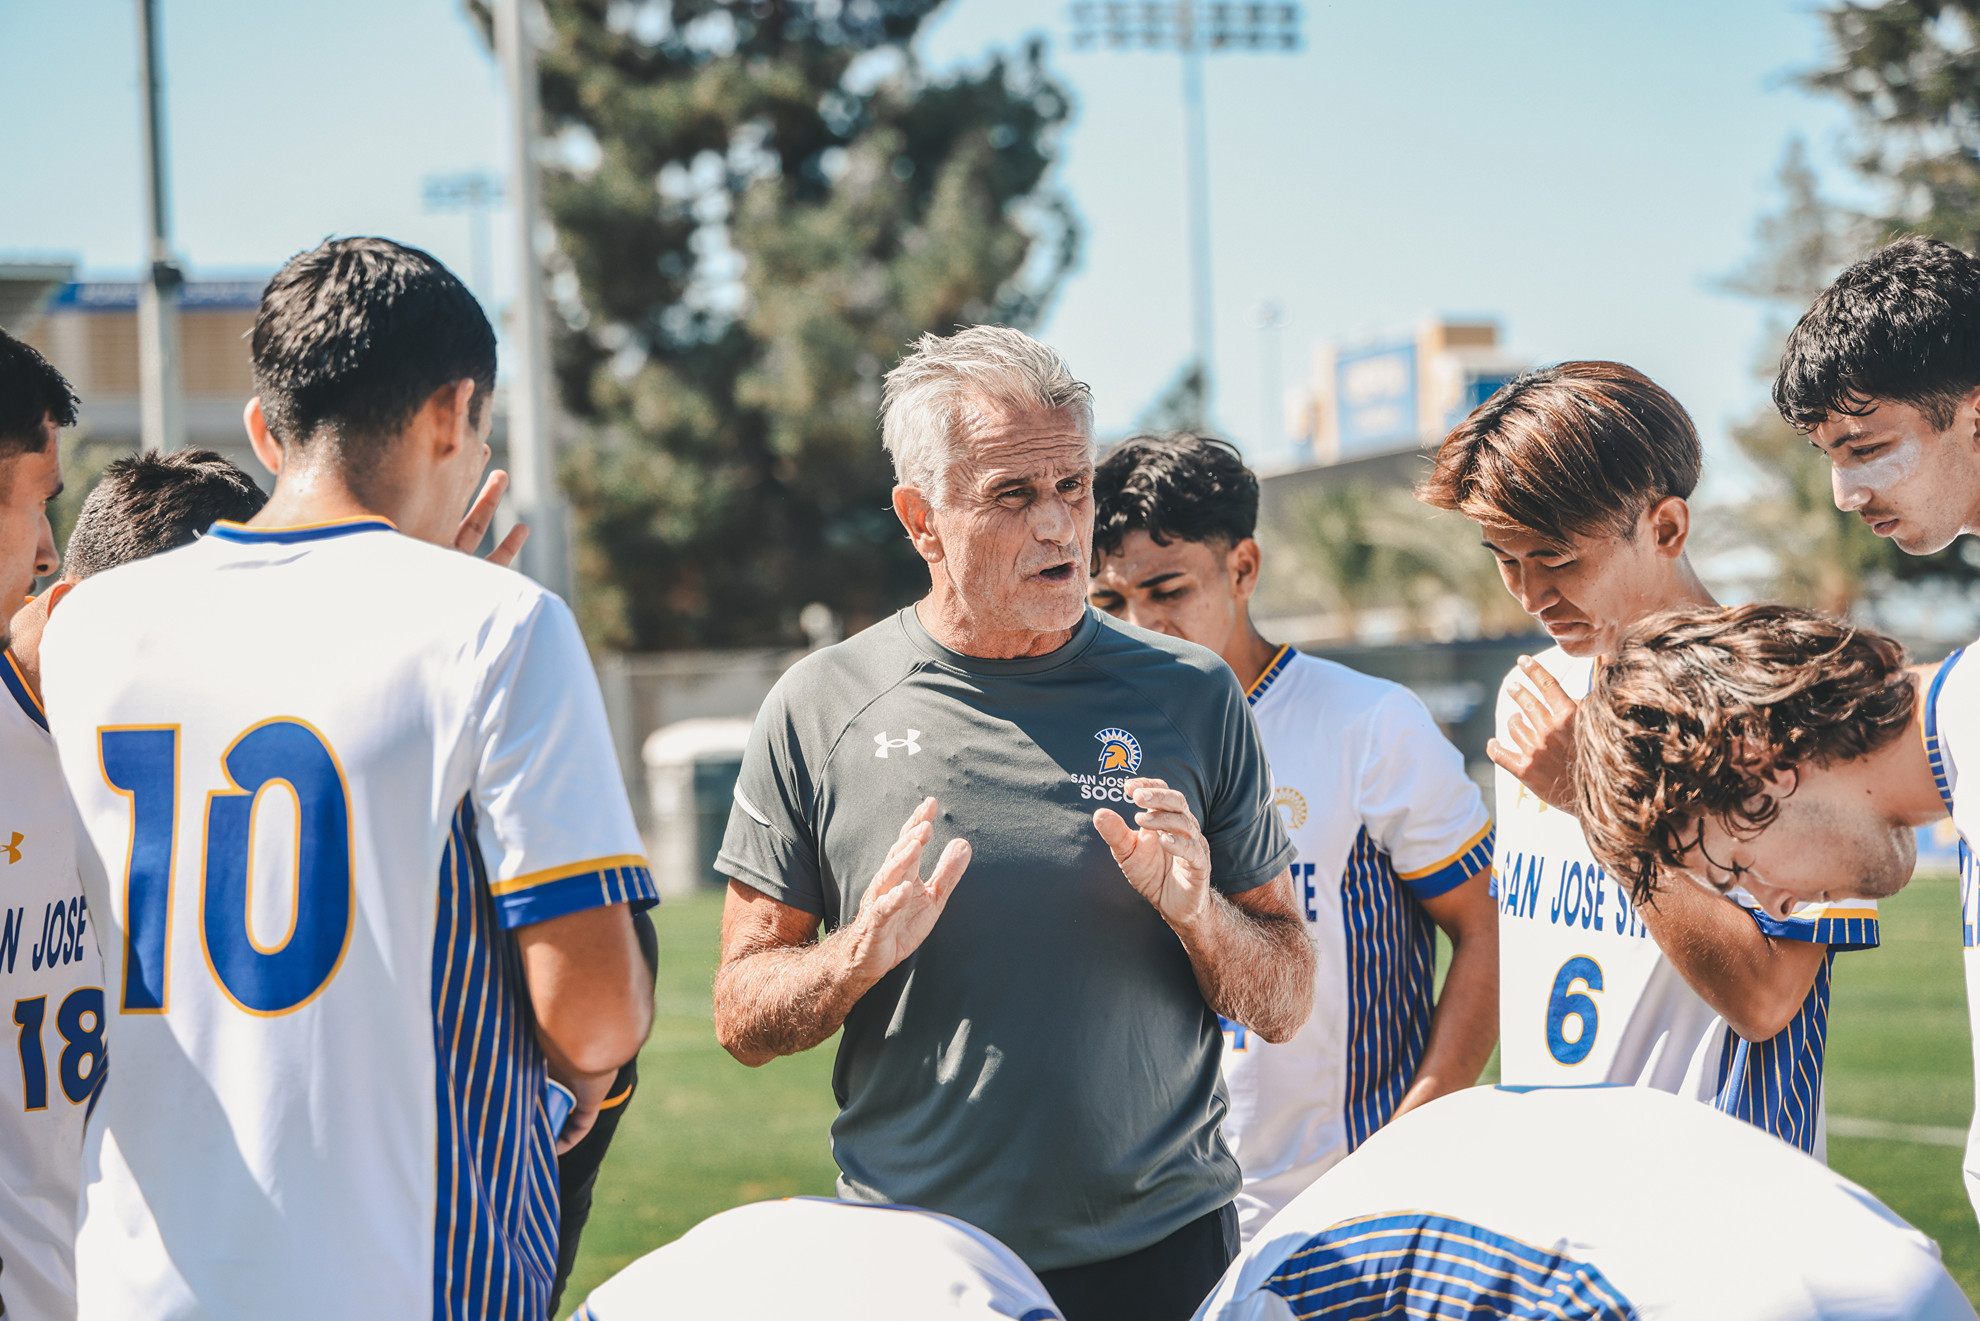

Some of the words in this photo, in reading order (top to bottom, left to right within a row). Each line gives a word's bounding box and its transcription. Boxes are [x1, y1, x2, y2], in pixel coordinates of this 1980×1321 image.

[1070, 773, 1096, 786] SAN
[1098, 775, 1130, 788] JOS
[97, 715, 356, 1018] 10
[1500, 850, 1545, 920] SAN
[1551, 860, 1605, 932] JOSE
[32, 895, 87, 972] JOSE
[12, 985, 107, 1112] 18
[1544, 954, 1605, 1068] 6
